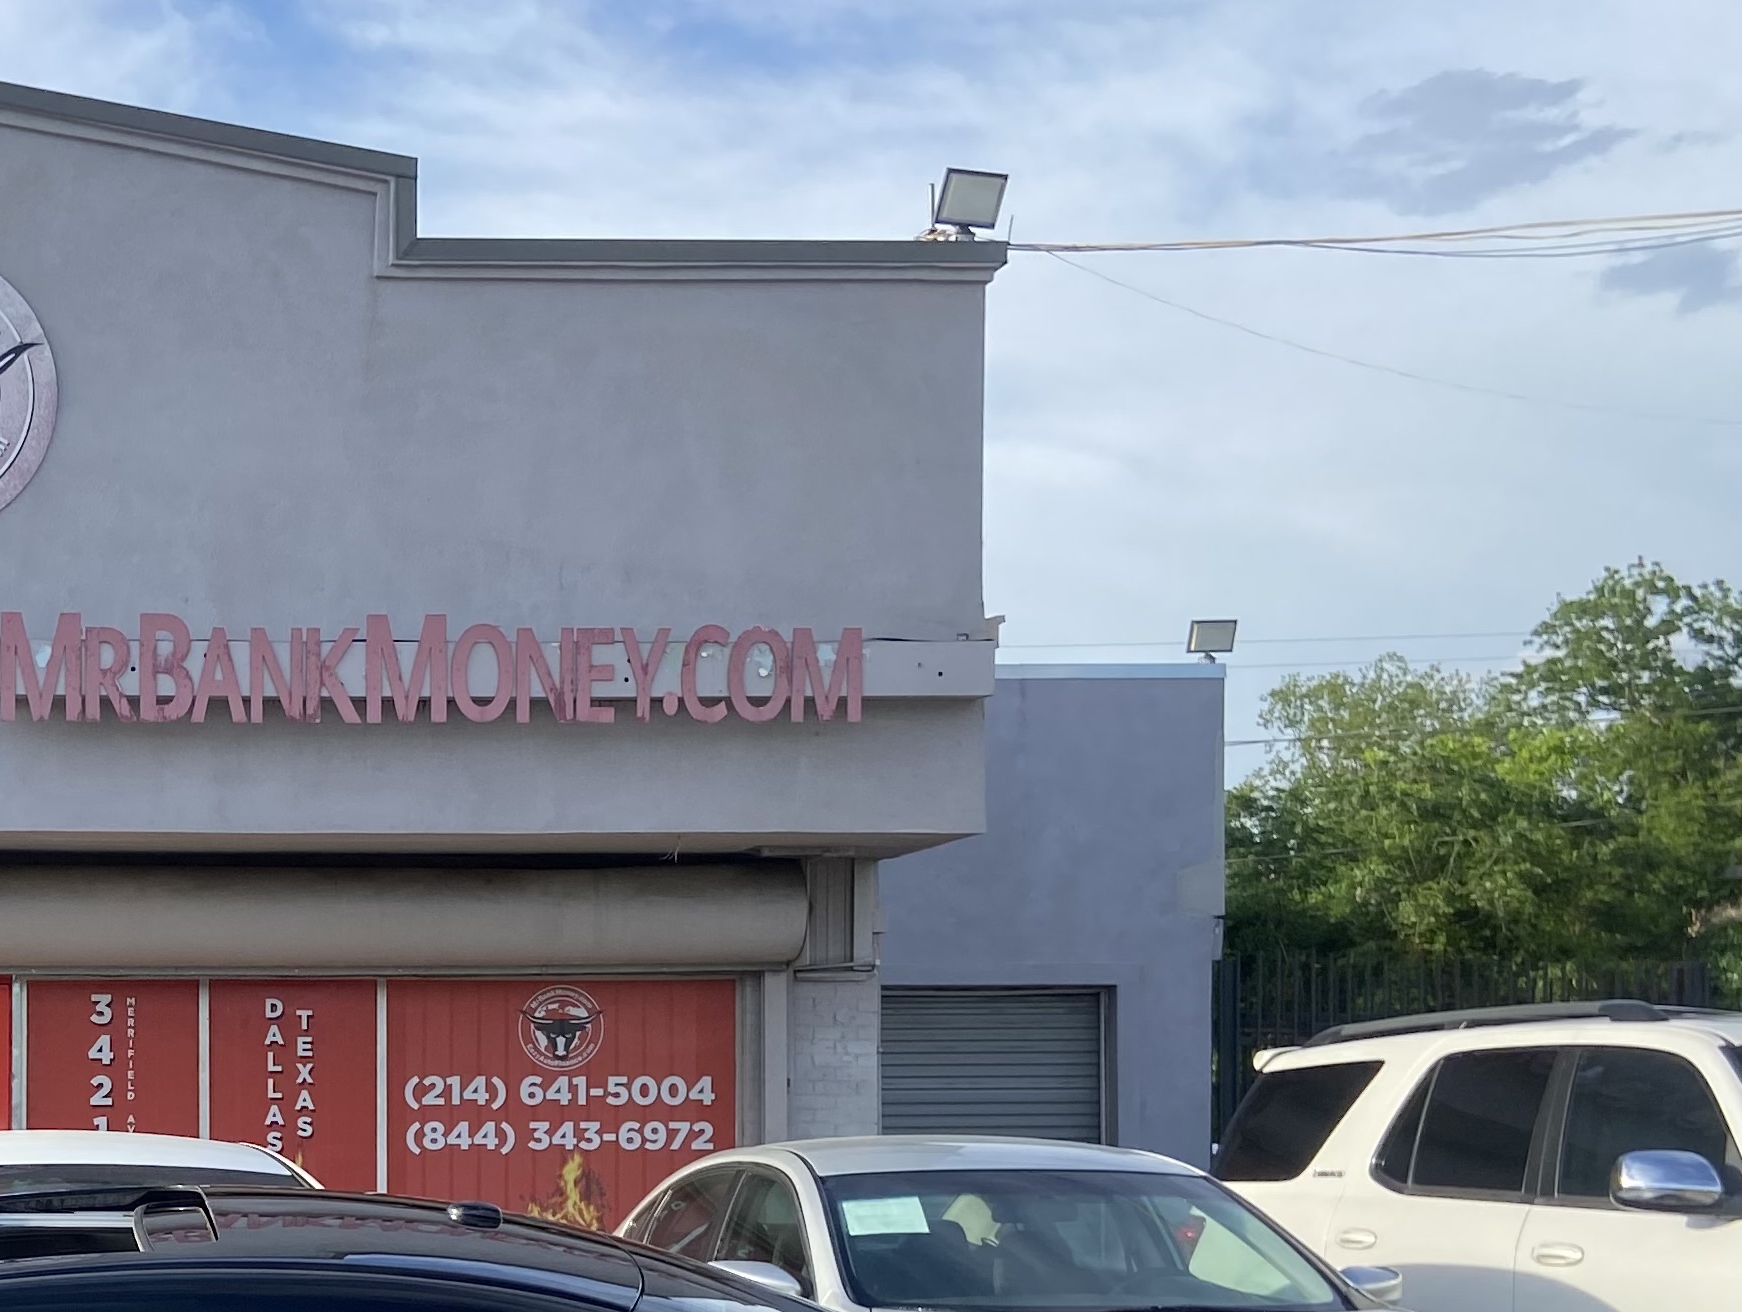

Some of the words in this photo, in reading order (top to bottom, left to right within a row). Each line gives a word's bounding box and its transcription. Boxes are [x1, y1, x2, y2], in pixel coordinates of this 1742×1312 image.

[126, 997, 136, 1101] MERRIFIELD
[263, 998, 285, 1152] DALLAS
[294, 1009, 315, 1137] TEXAS
[404, 1075, 507, 1111] (214)
[519, 1075, 716, 1106] 641-5004
[405, 1120, 516, 1156] (844)
[527, 1120, 715, 1151] 343-6972
